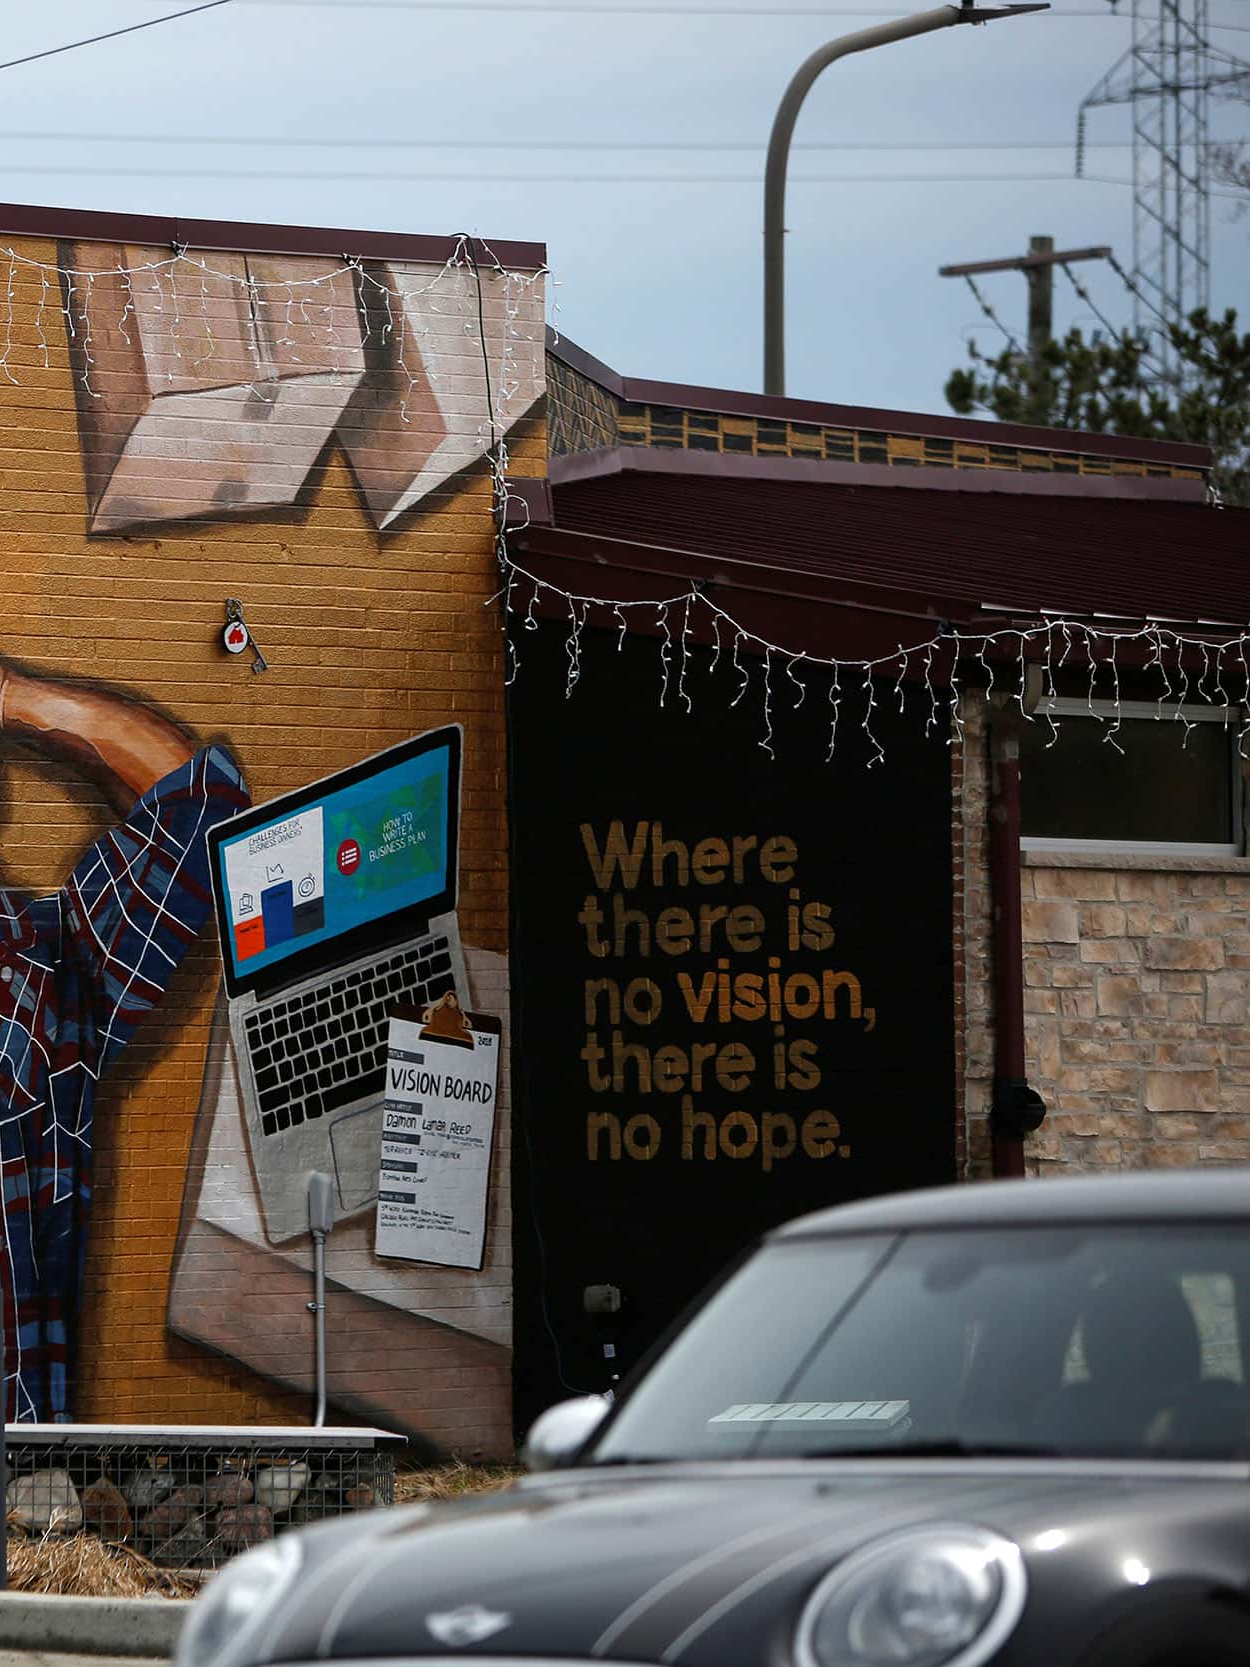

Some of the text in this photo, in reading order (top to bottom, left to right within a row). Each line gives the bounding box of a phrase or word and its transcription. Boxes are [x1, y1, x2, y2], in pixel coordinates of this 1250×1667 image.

[368, 837, 407, 862] BUSINESS
[382, 825, 407, 842] WRITE
[580, 820, 799, 890] Where
[578, 887, 836, 957] there is
[585, 956, 877, 1032] no vision,
[390, 1067, 493, 1104] VISION BOARD
[580, 1023, 822, 1093] there is
[586, 1094, 851, 1172] no hope.
